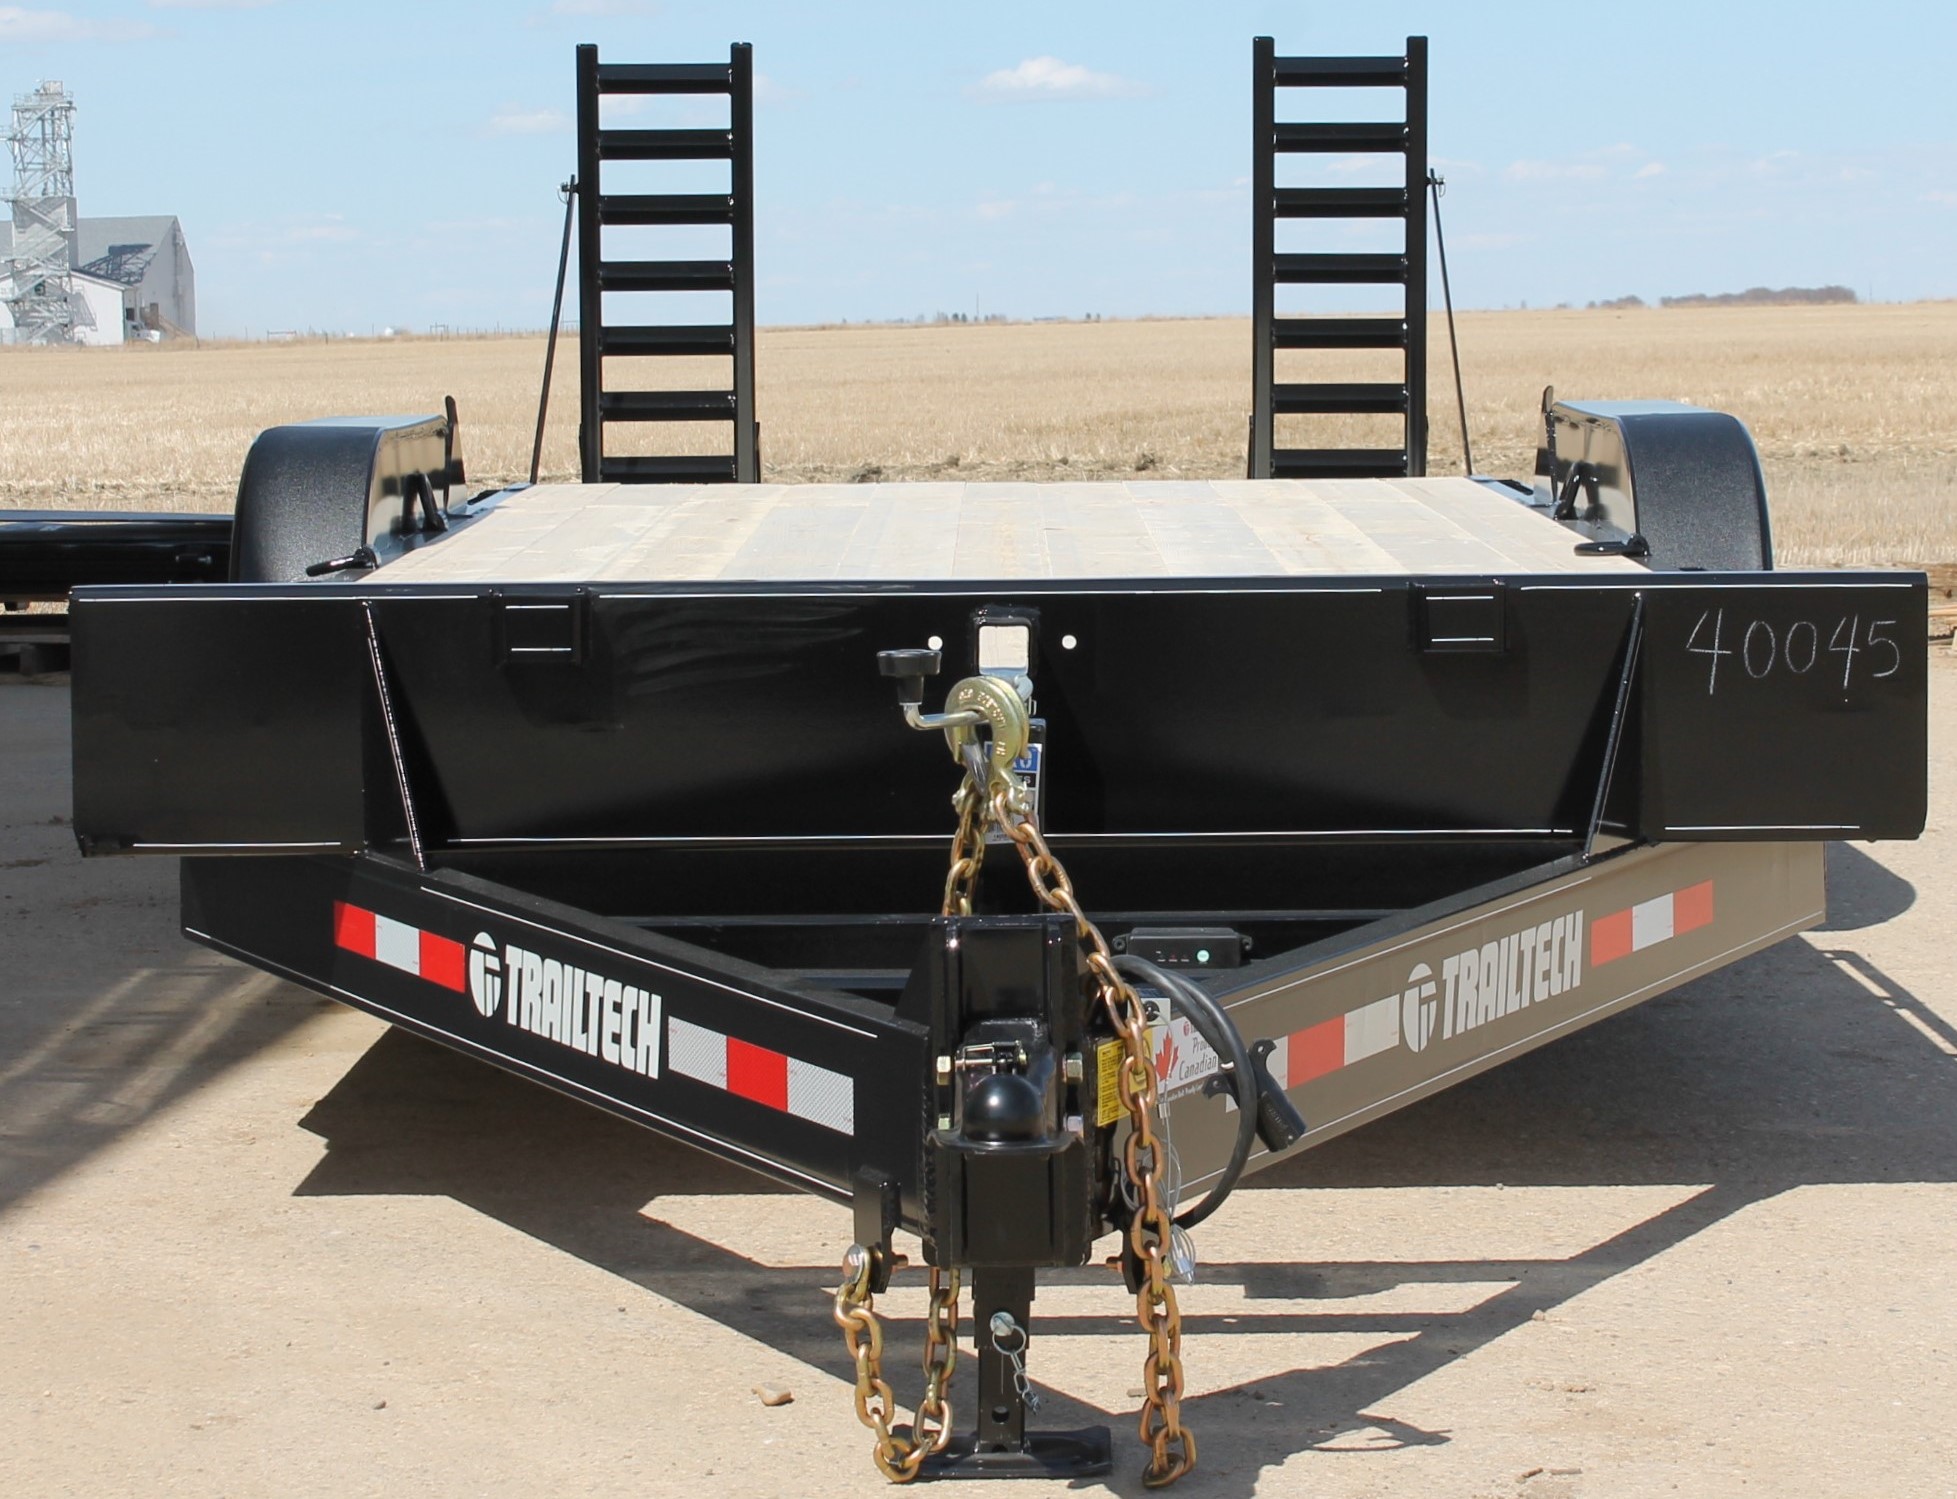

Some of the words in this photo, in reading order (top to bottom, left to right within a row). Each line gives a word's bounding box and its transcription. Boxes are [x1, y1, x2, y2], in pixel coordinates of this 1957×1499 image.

[1686, 607, 1900, 696] 40045
[505, 944, 661, 1080] TRAILTECH
[1442, 909, 1583, 1040] TRAILTECH
[1179, 1053, 1218, 1081] Canadian
